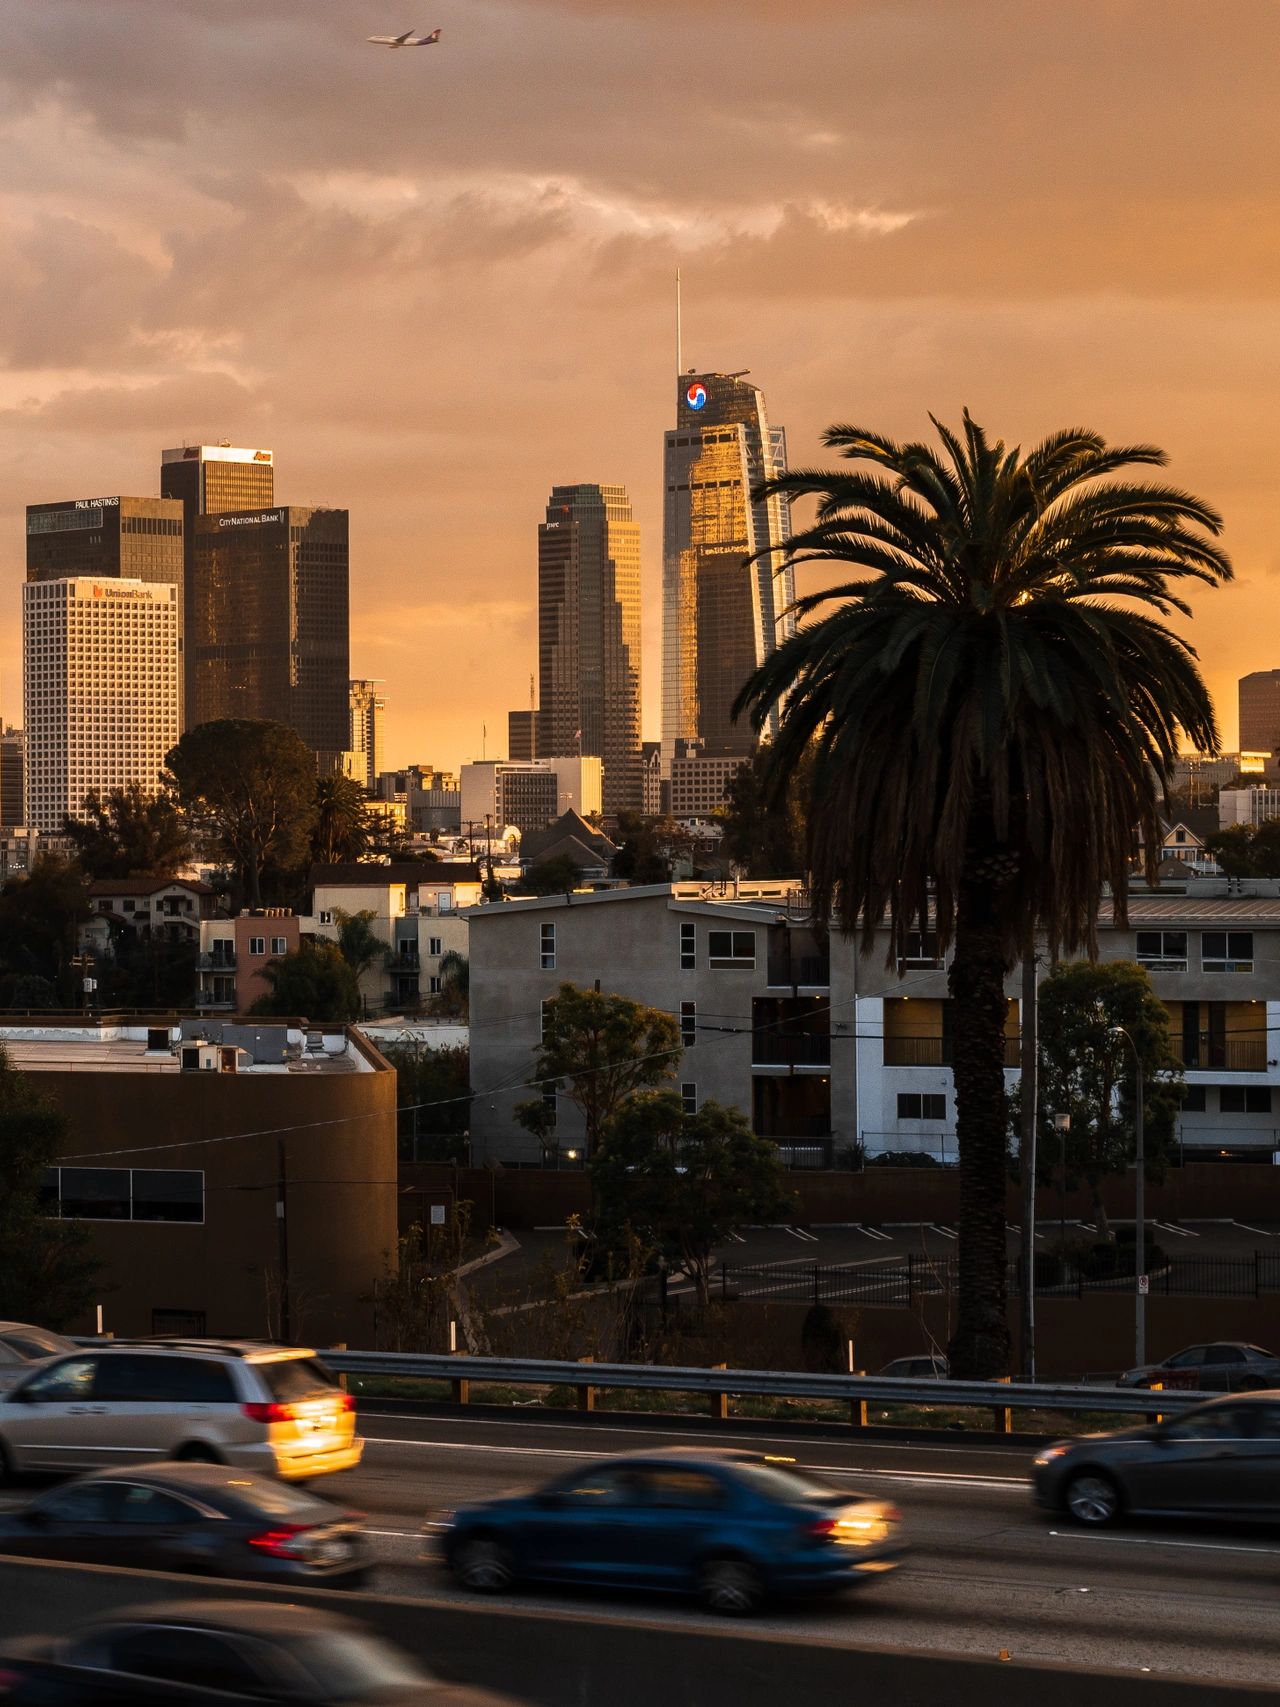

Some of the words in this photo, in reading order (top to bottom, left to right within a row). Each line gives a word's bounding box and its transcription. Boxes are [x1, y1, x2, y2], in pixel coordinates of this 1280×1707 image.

[75, 500, 90, 509] PAUL
[90, 497, 119, 508] HASTINGS
[231, 516, 261, 526] NATIONAL
[261, 514, 279, 522] BANK
[546, 522, 560, 530] pwc
